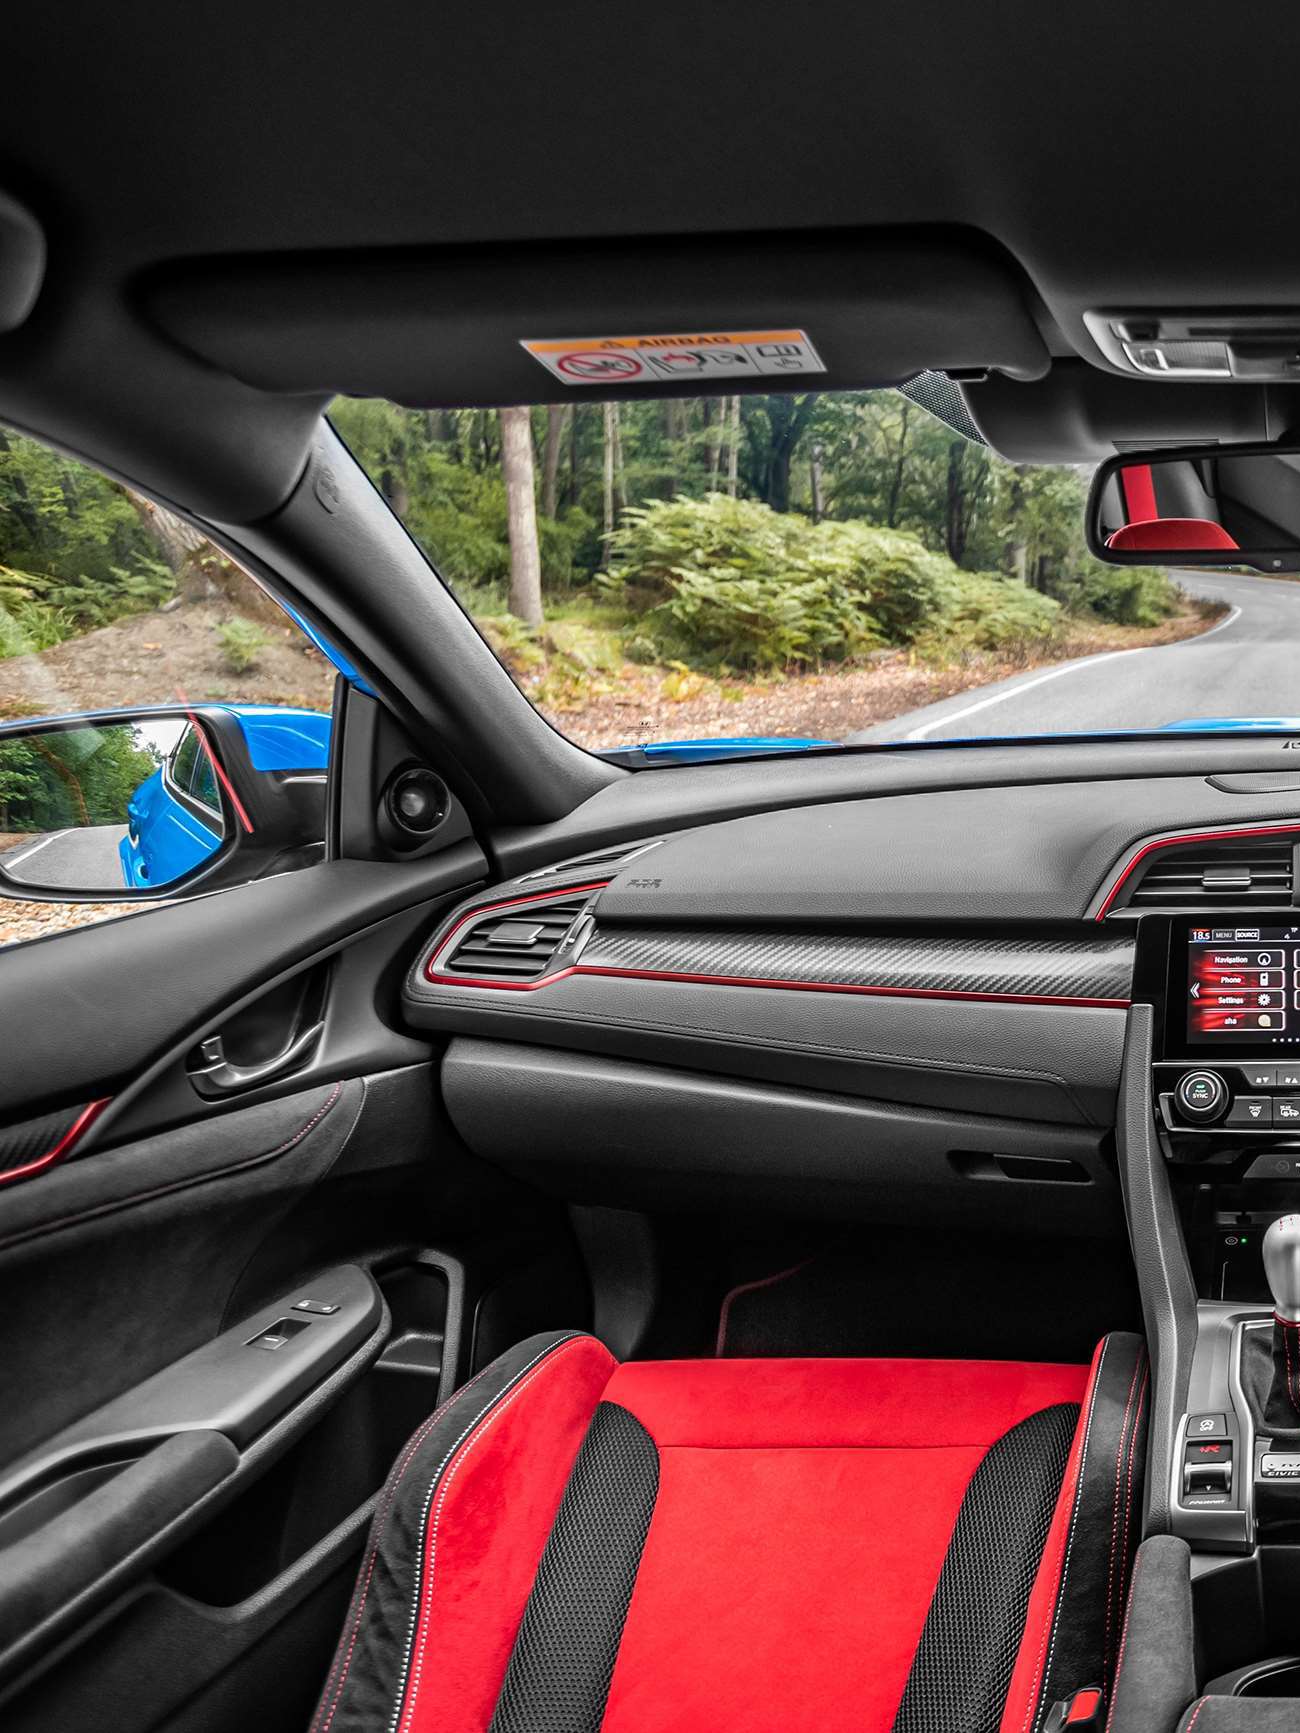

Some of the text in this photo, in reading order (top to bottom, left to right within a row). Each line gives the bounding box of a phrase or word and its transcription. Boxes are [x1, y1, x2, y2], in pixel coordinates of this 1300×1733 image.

[638, 335, 731, 348] AIRBAG
[1214, 956, 1249, 964] Navigation
[1220, 976, 1242, 984] Phone
[1217, 997, 1245, 1005] Settings
